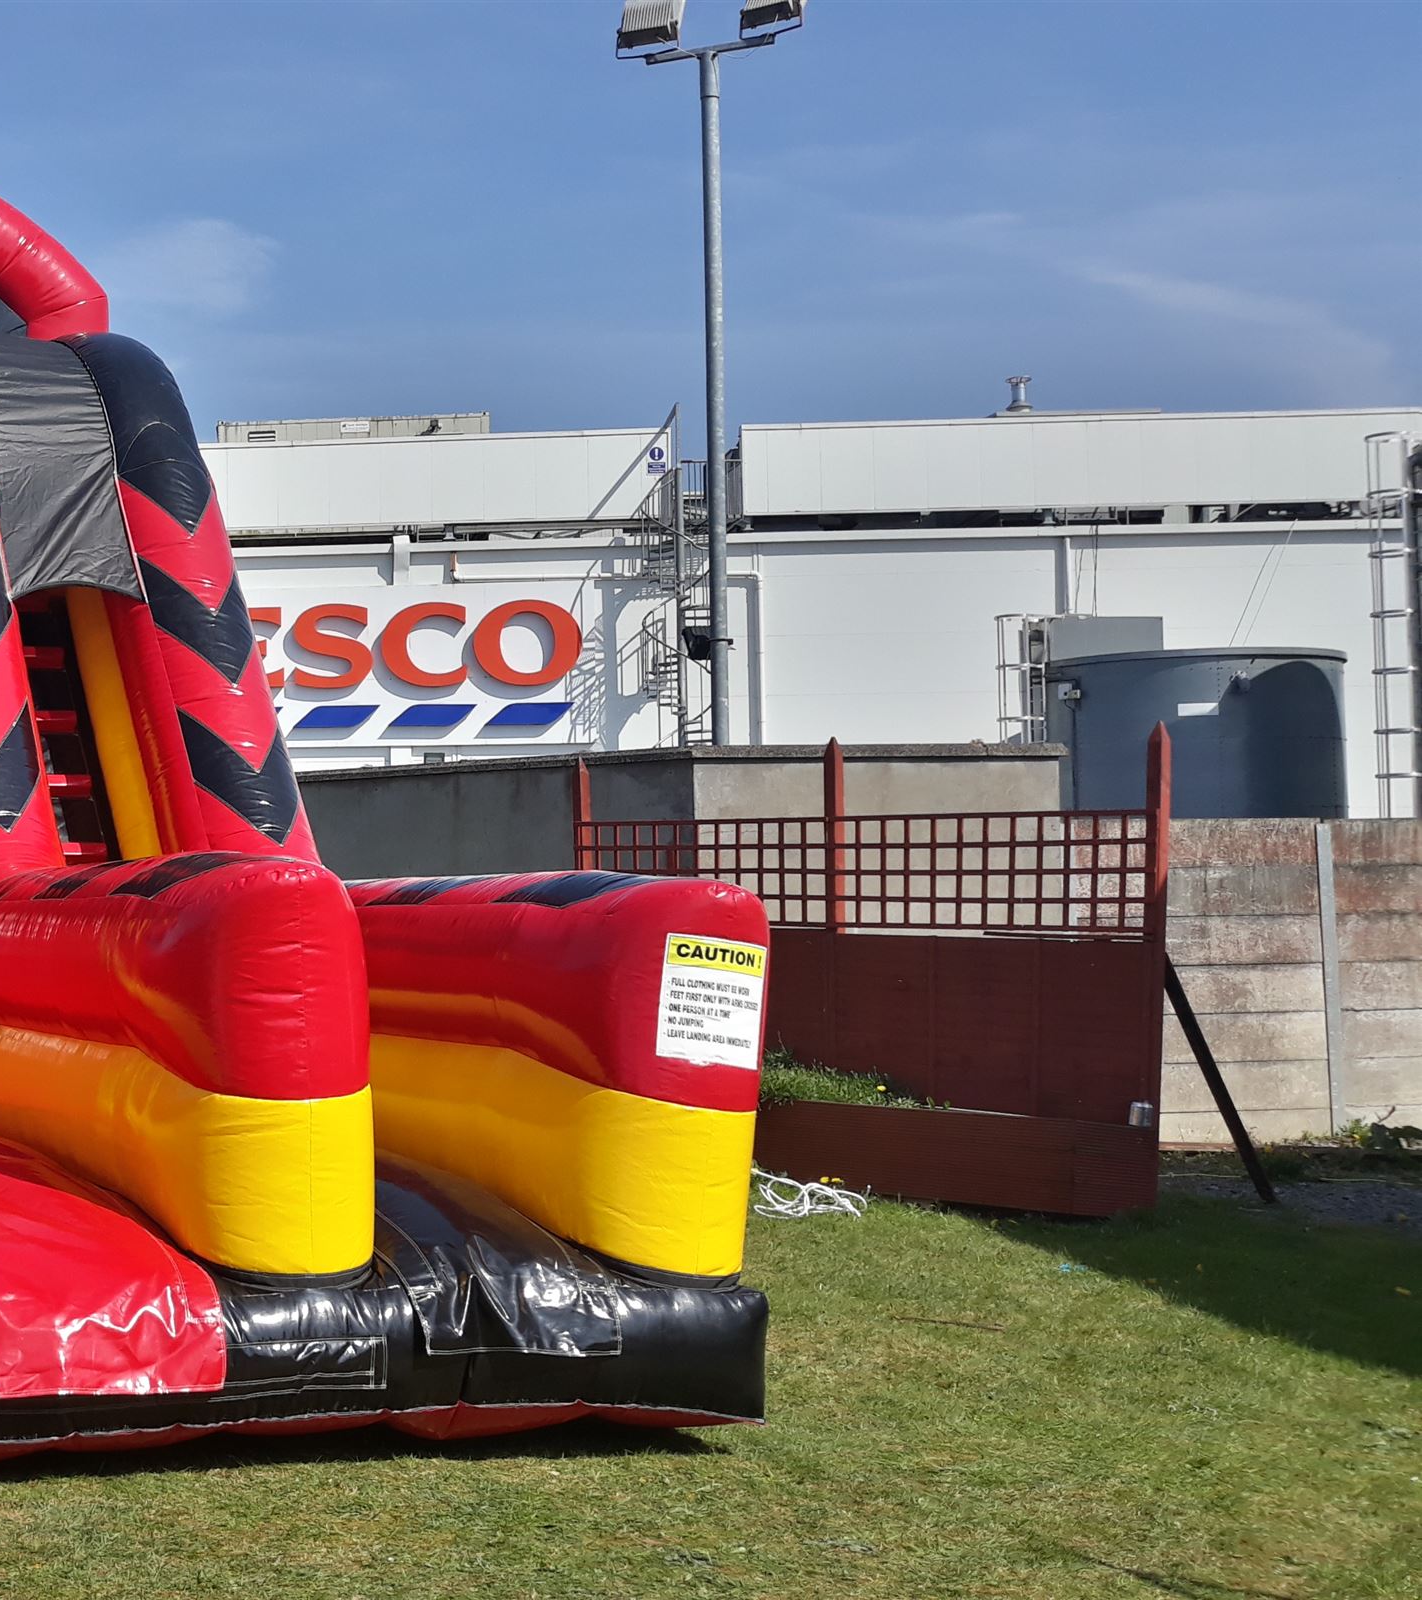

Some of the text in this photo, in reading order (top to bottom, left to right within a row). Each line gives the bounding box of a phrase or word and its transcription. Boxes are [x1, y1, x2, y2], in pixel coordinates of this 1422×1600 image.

[676, 943, 756, 967] CAUTION
[671, 977, 685, 987] FULL
[686, 979, 715, 990] CLOTHING
[716, 983, 730, 993] MUST
[670, 990, 684, 999] FEET
[685, 992, 702, 1002] FIRST
[703, 994, 717, 1004] ONLY
[718, 996, 730, 1005] WITH
[669, 1003, 681, 1012] ONE
[682, 1005, 705, 1015] PERSON
[707, 1008, 714, 1016] AT
[719, 1009, 731, 1019] TIME
[668, 1016, 704, 1028] NO JUMPING
[667, 1029, 685, 1039] LEAVE
[686, 1030, 711, 1042] LANDING
[712, 1035, 725, 1044] AREA
